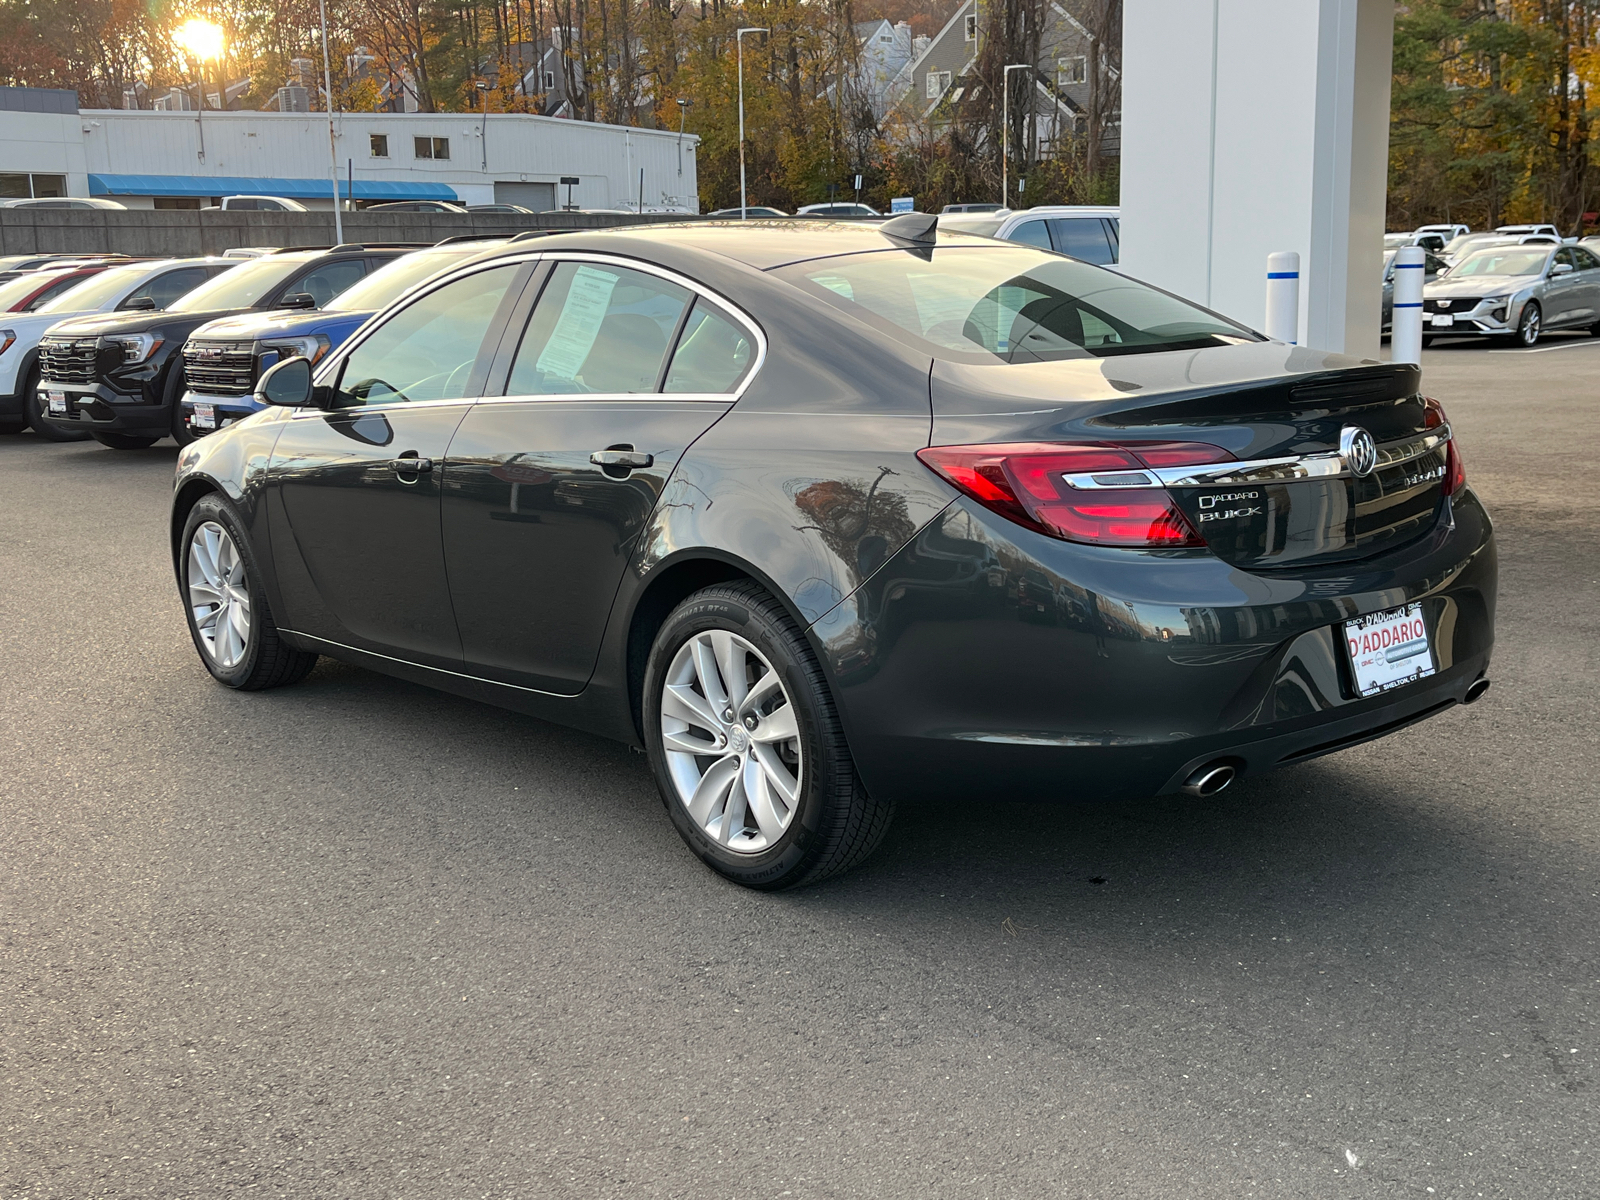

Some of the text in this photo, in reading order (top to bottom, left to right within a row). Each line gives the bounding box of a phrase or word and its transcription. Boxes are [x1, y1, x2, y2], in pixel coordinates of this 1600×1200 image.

[1199, 506, 1263, 523] BUICK
[1346, 618, 1364, 627] BUICK
[1407, 602, 1422, 610] GMC
[1348, 618, 1423, 657] D'ADDARIO
[1361, 658, 1375, 667] GMC
[1362, 687, 1380, 697] NISSAN
[1409, 674, 1418, 682] CT
